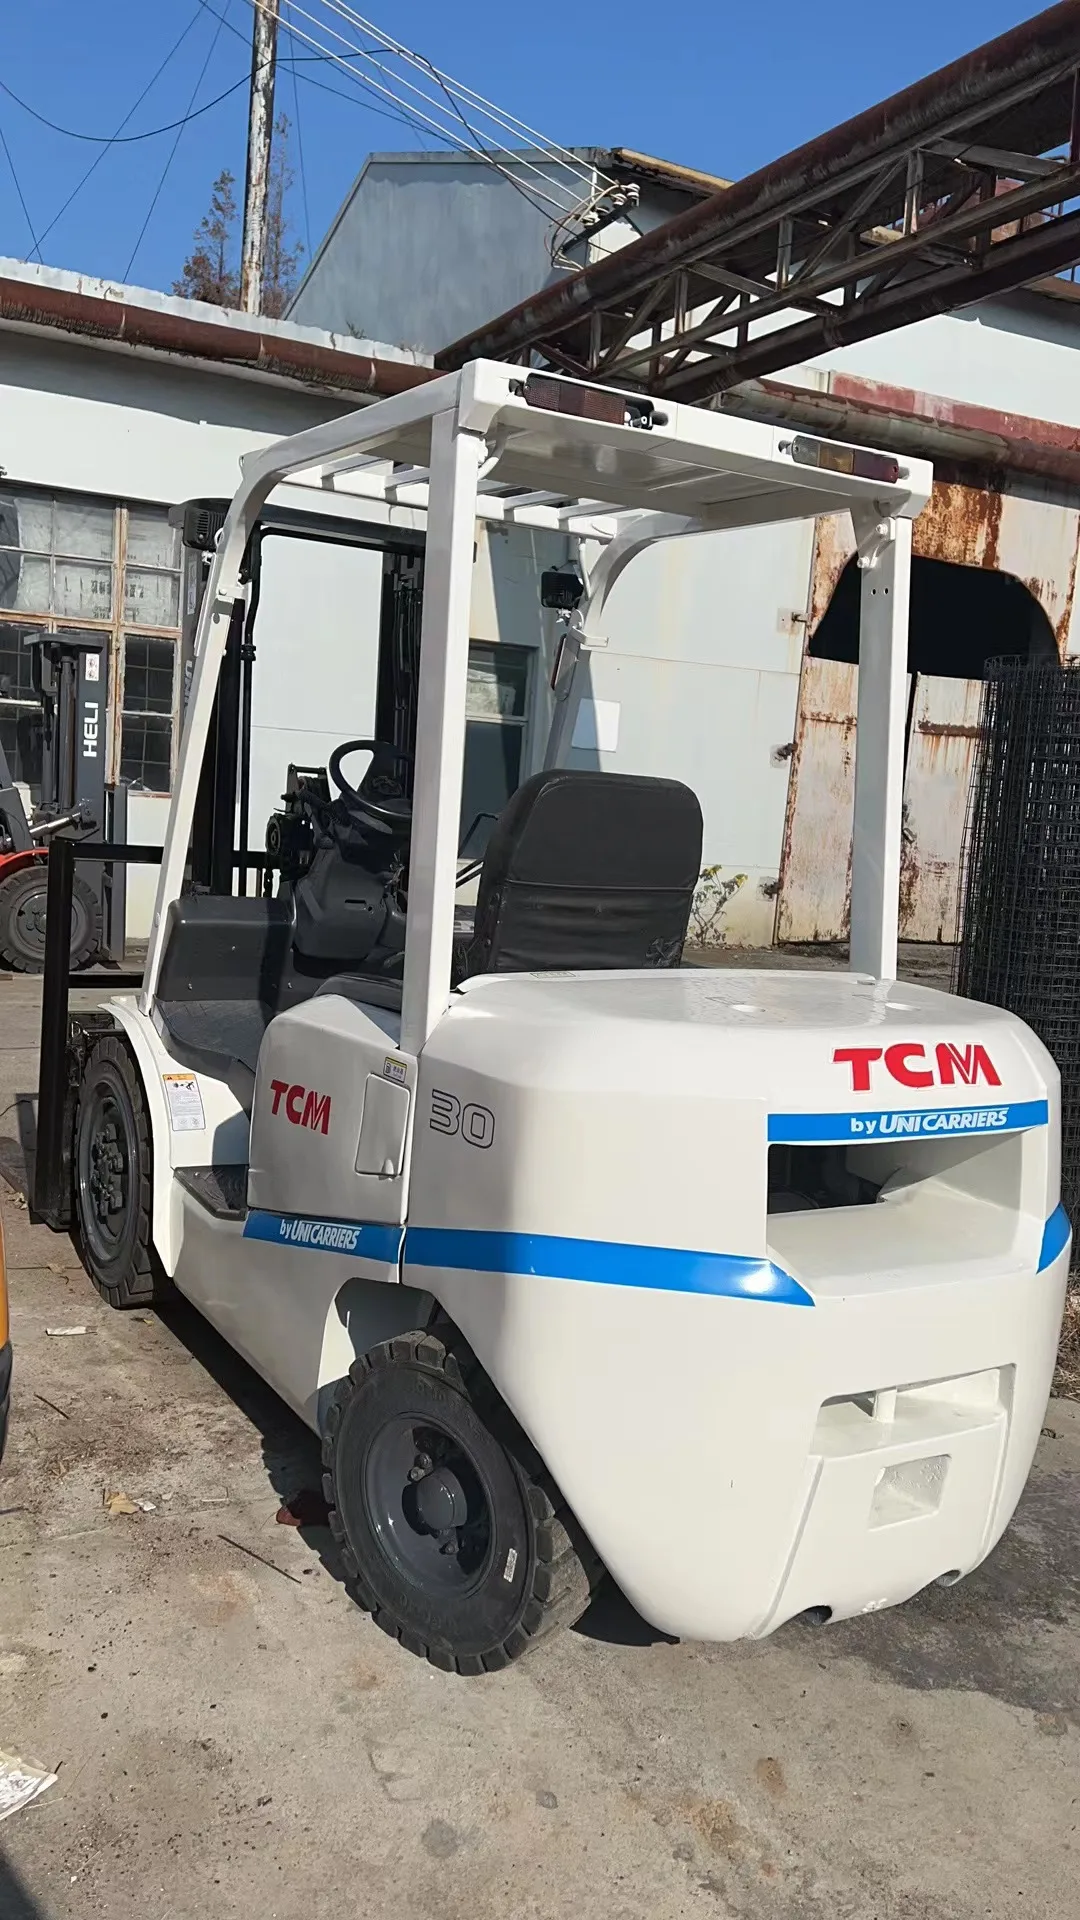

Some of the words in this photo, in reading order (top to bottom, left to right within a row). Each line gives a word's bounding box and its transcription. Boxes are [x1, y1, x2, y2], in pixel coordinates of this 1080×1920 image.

[83, 701, 98, 757] HELI
[833, 1043, 1002, 1091] TCM
[270, 1079, 331, 1135] TCM
[430, 1088, 495, 1149] 30
[851, 1117, 877, 1135] by
[879, 1108, 1009, 1133] UNICARRIERS
[280, 1219, 293, 1239] by
[291, 1220, 362, 1249] UNICARRIERS
